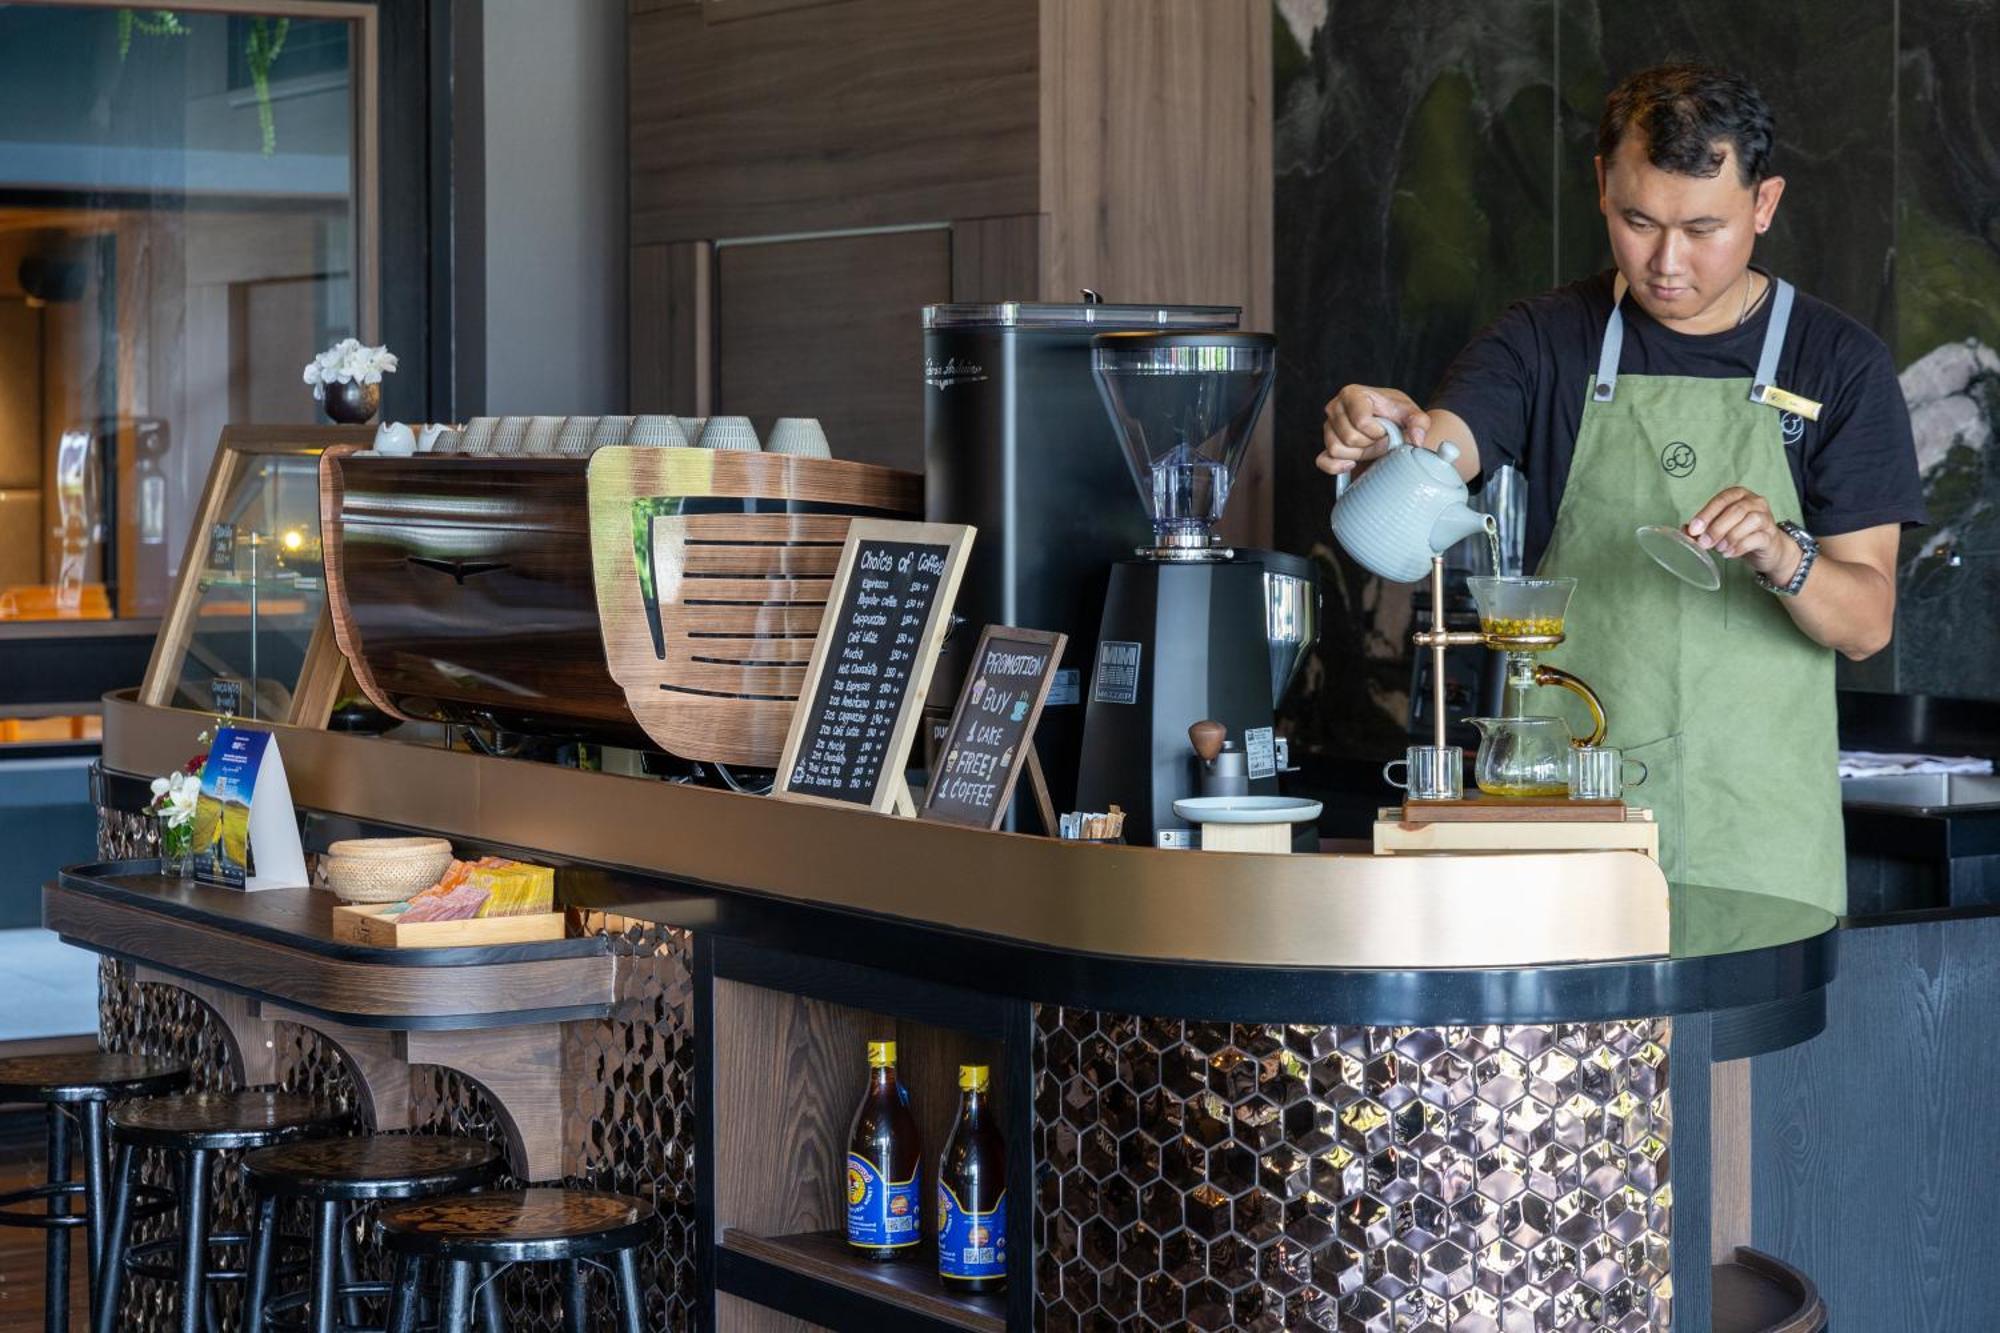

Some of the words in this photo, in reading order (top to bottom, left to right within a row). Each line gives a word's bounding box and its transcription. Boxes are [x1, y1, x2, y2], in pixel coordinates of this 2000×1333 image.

[861, 550, 893, 572] Choice
[898, 551, 914, 573] of
[917, 553, 945, 576] Coffee
[983, 651, 1047, 676] PROMOTION
[982, 687, 1013, 715] BUY
[966, 720, 978, 742] 1
[976, 725, 1005, 746] CAKE
[955, 751, 998, 781] FREE!
[938, 777, 950, 799] 1
[950, 777, 996, 807] COFFEE
